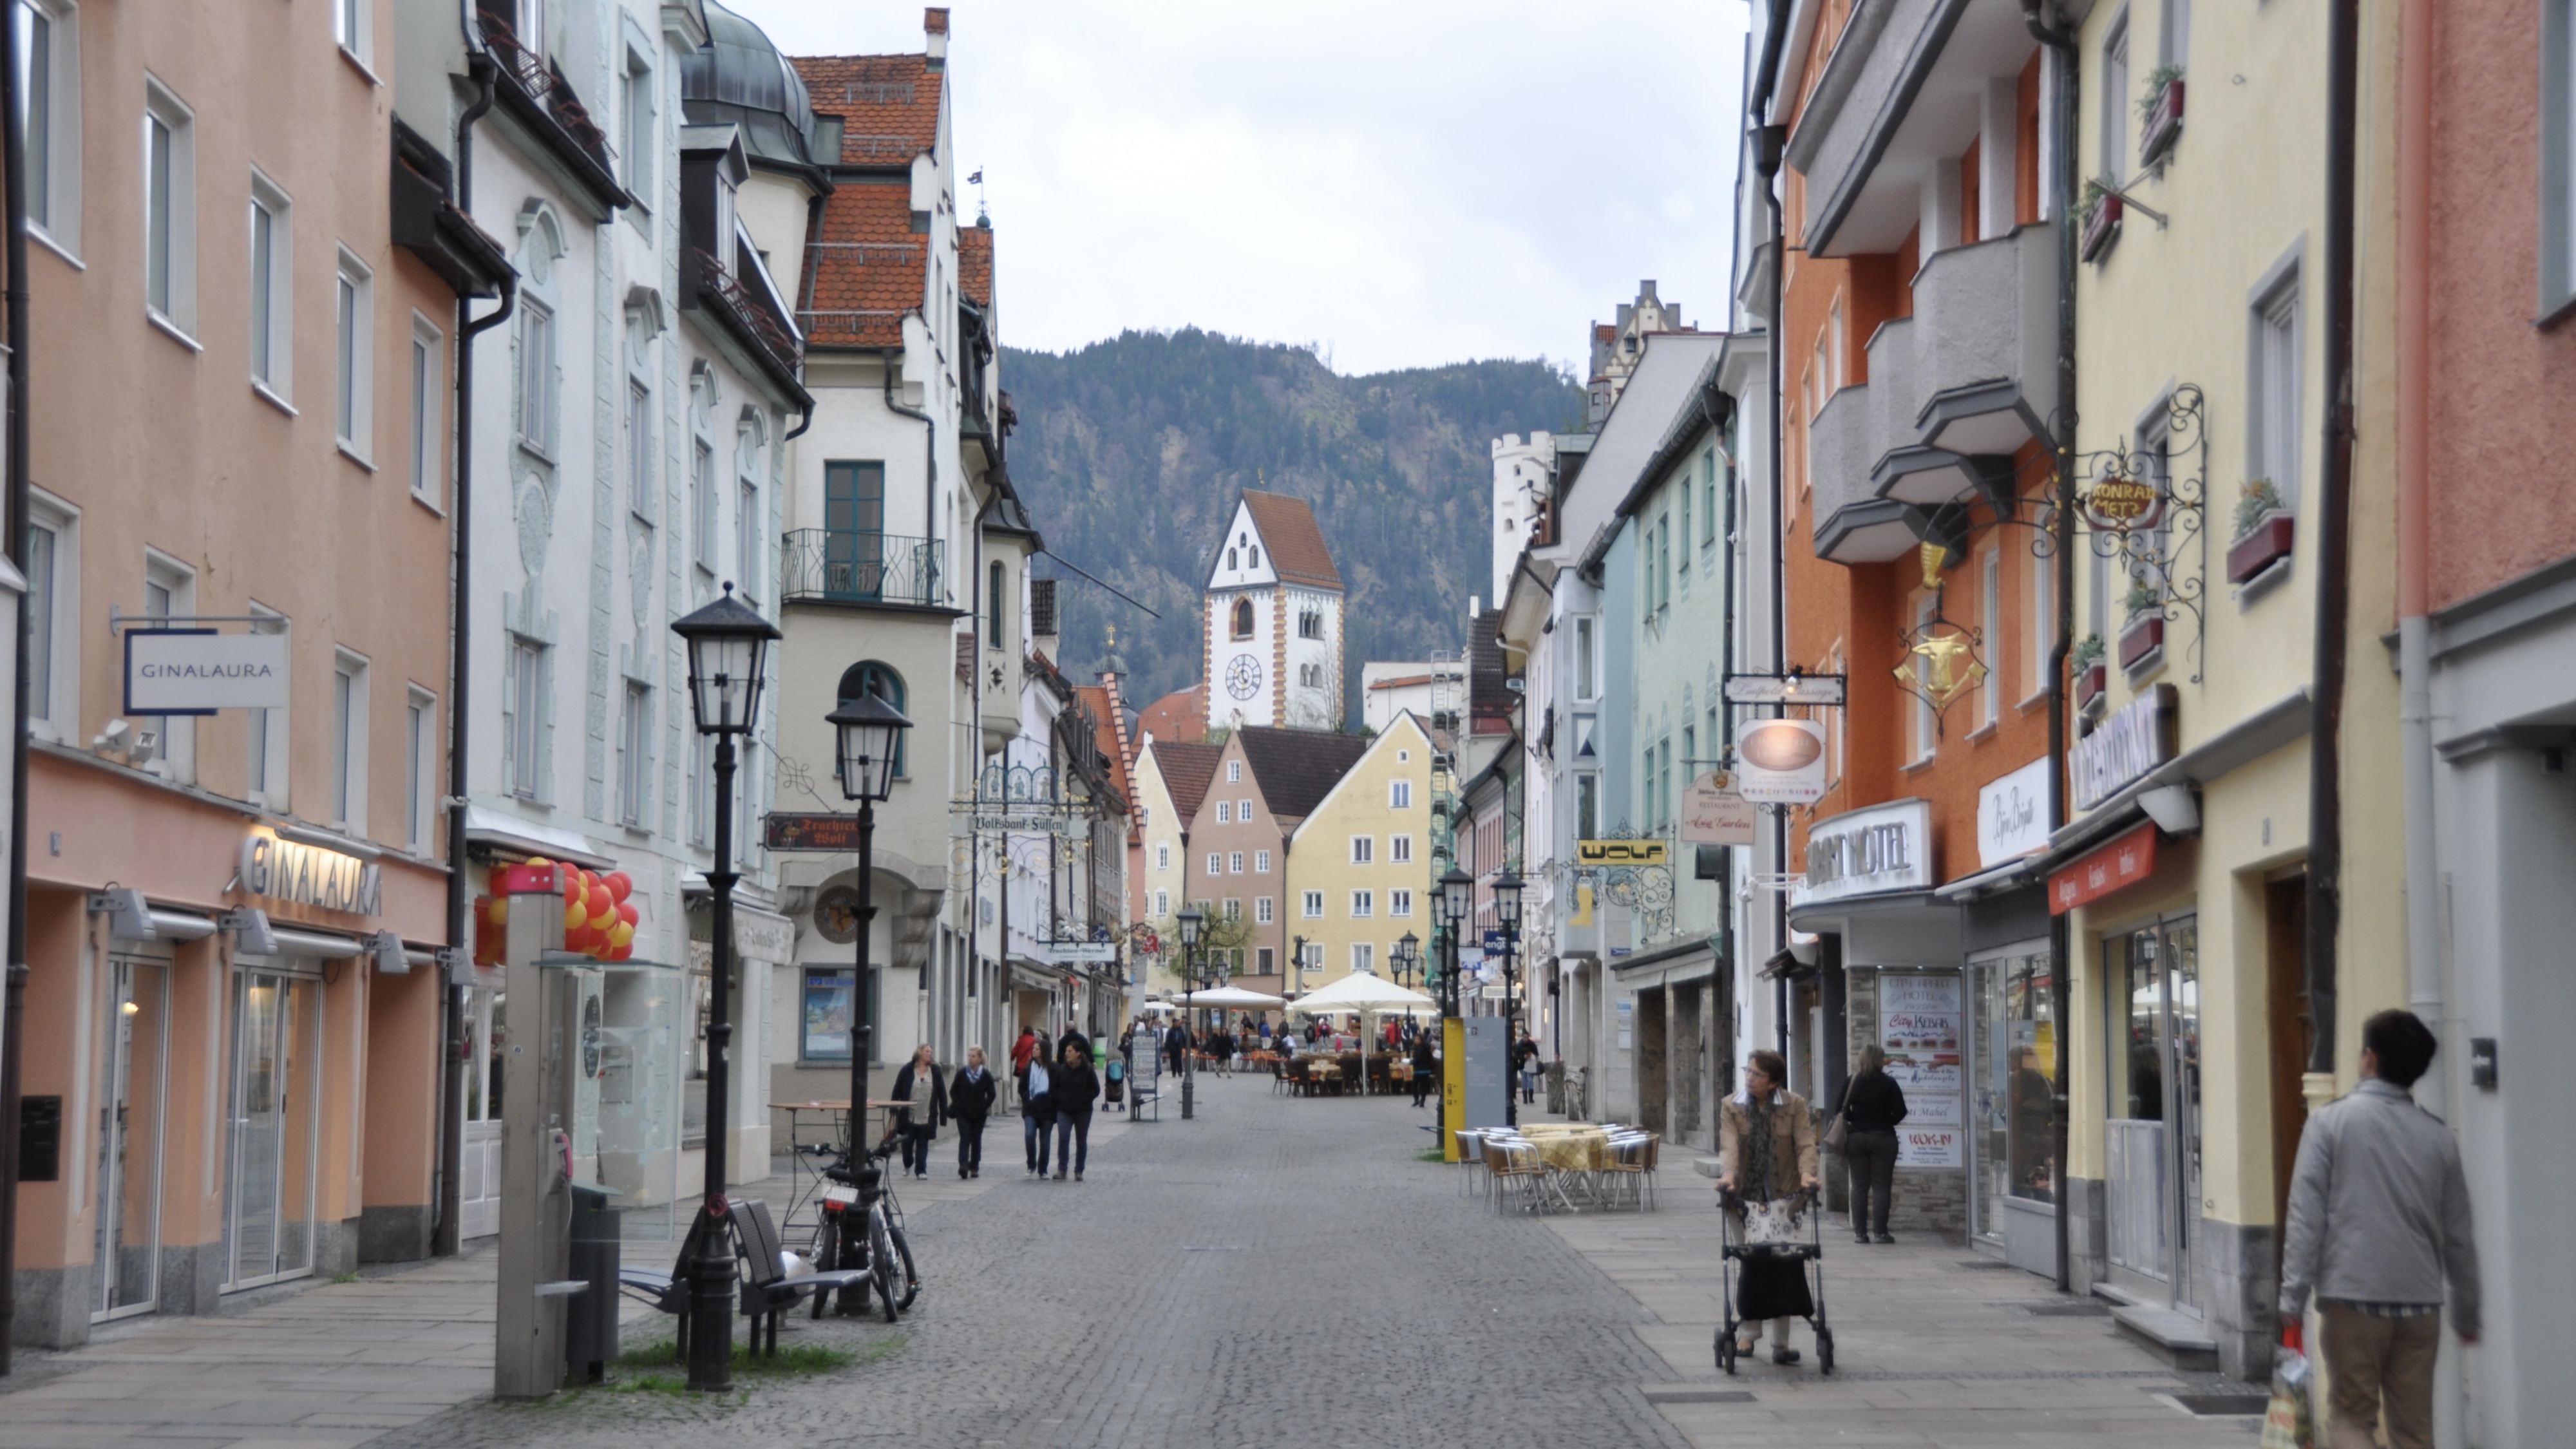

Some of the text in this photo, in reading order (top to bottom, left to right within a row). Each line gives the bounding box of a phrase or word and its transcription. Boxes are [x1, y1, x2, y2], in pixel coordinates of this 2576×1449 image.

[2092, 483, 2157, 499] KONRAD
[2092, 498, 2141, 517] METZ
[141, 664, 272, 677] GINALAURA
[1699, 801, 1741, 810] RESTAURANT
[1581, 846, 1663, 859] WOLF
[252, 837, 382, 917] GINALAURA
[1909, 1133, 1951, 1146] WOK-IN
